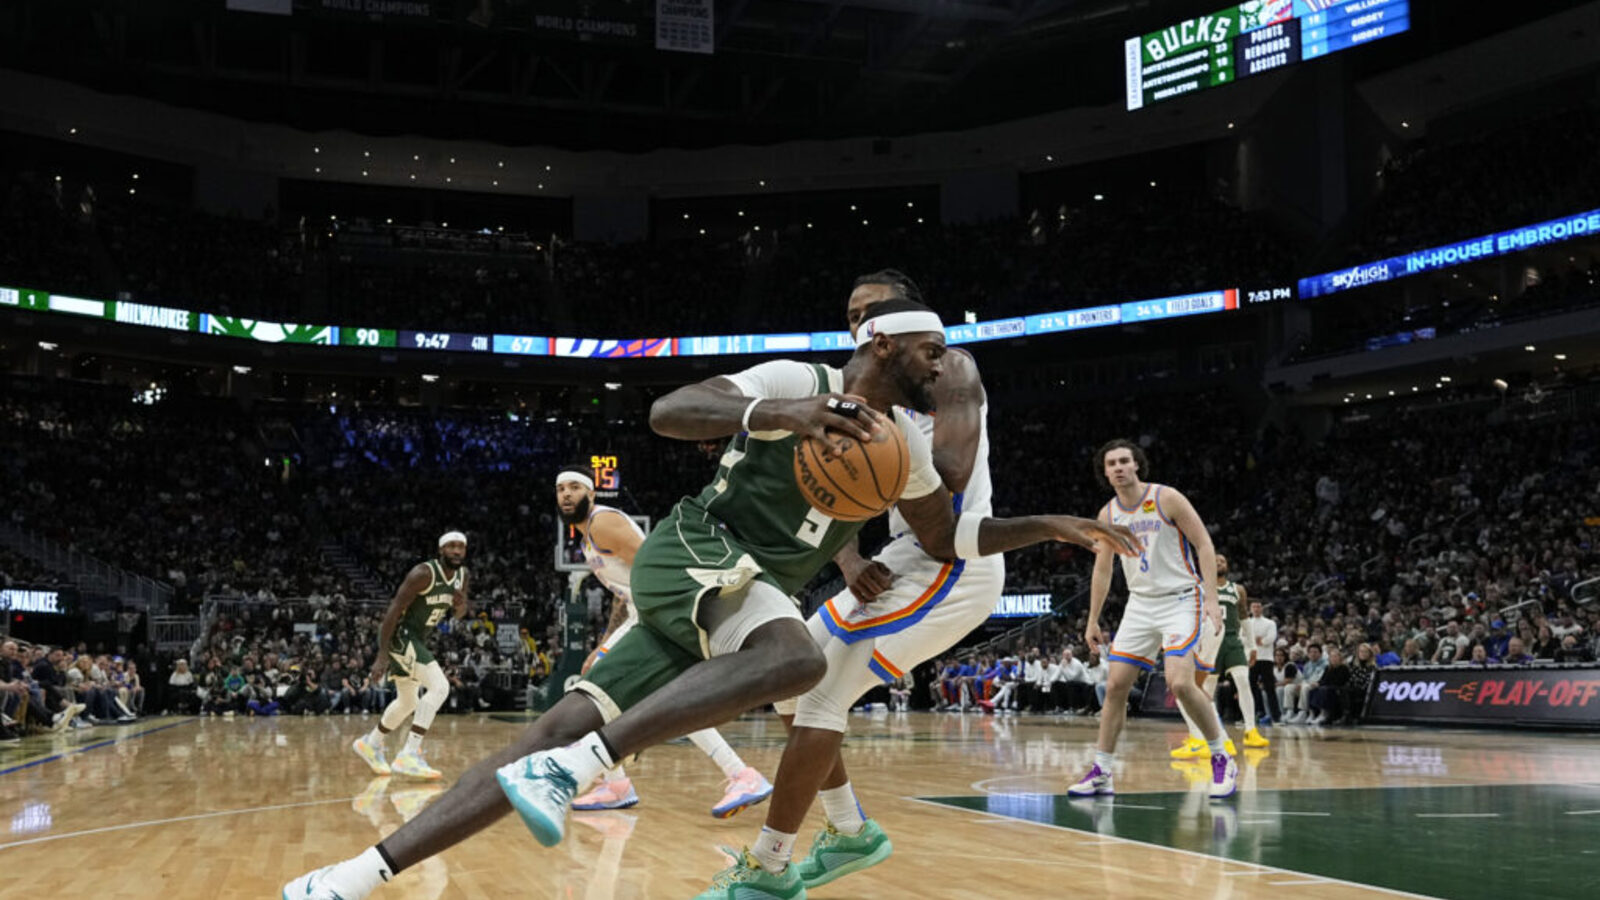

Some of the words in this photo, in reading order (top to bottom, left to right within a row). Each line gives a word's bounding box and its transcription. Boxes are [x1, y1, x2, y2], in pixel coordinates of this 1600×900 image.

[575, 19, 637, 37] CHAMPIONS
[1251, 24, 1283, 44] POINTS
[1146, 16, 1231, 61] BUCKS
[1245, 37, 1290, 60] REBOUNDS
[1250, 52, 1287, 73] ASSISTS
[1406, 238, 1494, 272] IN-HOUSE
[1498, 214, 1600, 251] EMBROIDE
[1333, 264, 1388, 288] SKYHIGH
[28, 294, 35, 306] 1
[1191, 296, 1213, 311] GOALS
[1248, 292, 1270, 304] 7:53
[1273, 288, 1290, 300] PM
[116, 301, 189, 331] MILWAUKEE
[357, 329, 379, 346] 90
[415, 333, 449, 349] 9:47
[511, 337, 532, 352] 67
[594, 467, 614, 489] 15
[1379, 682, 1444, 702] $100K
[1475, 680, 1599, 707] PLAY-OFF
